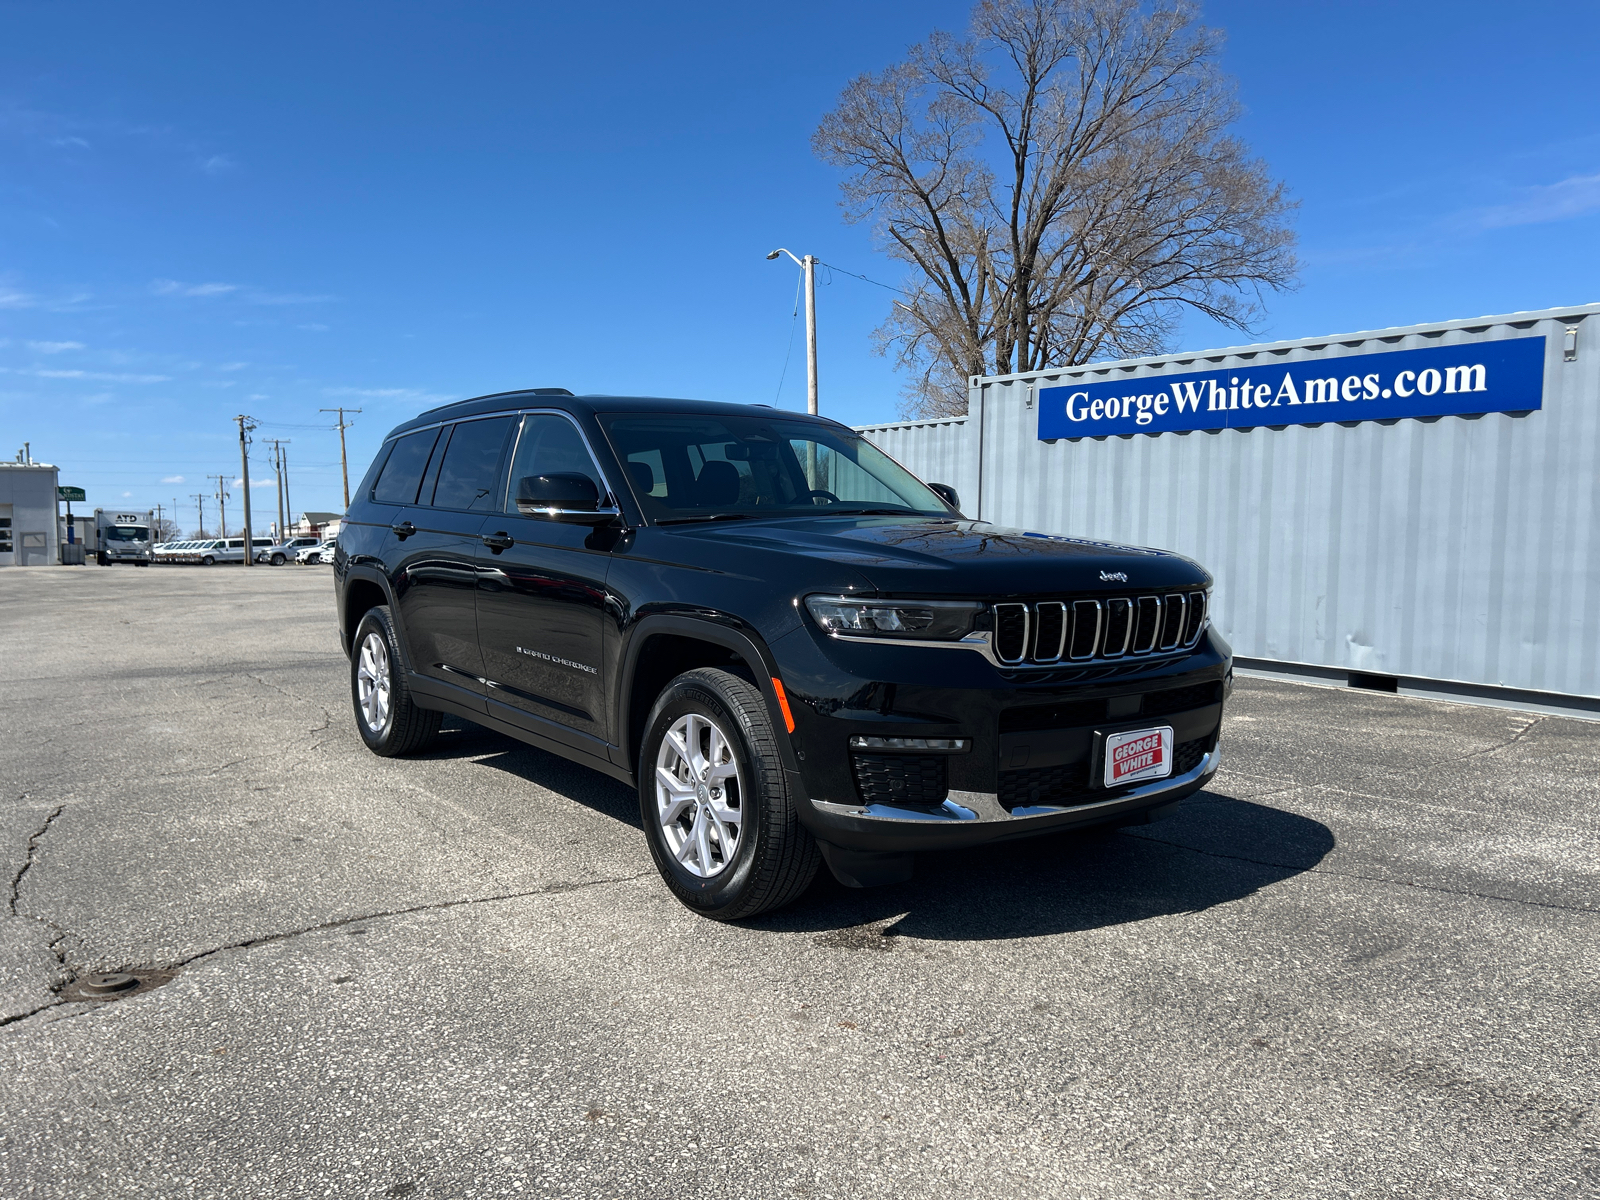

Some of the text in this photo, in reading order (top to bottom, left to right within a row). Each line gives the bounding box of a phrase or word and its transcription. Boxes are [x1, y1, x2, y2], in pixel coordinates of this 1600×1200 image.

[1065, 362, 1488, 425] GeorgeWhiteAmes.com
[115, 514, 137, 523] ATD
[1099, 570, 1128, 583] Jeep
[523, 648, 598, 675] GRAND CHEROKEE
[686, 690, 722, 717] MICHELIN
[1115, 735, 1159, 760] GEORGE
[1120, 752, 1154, 774] WHITE
